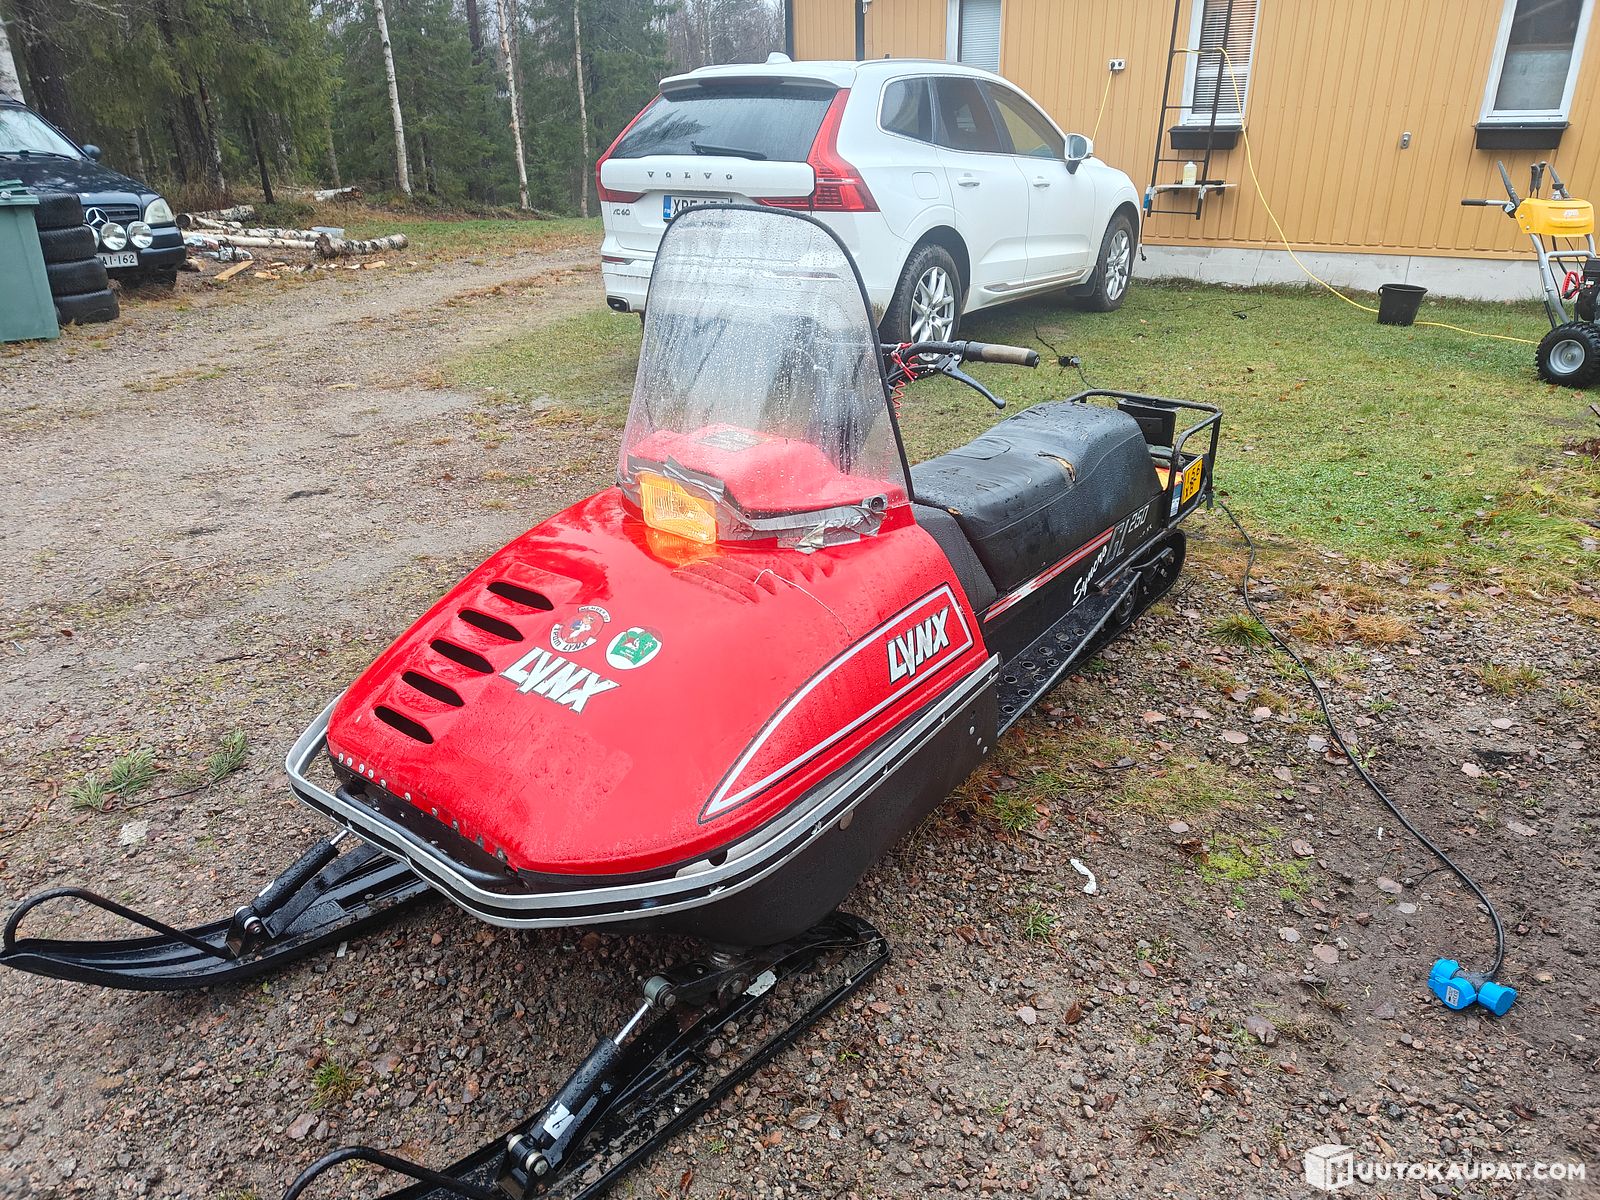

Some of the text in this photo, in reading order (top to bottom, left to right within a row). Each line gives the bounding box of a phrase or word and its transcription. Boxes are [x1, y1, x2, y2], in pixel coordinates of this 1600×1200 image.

[647, 170, 733, 181] VOLVO
[887, 605, 950, 685] LYNX
[498, 646, 621, 714] LYNX
